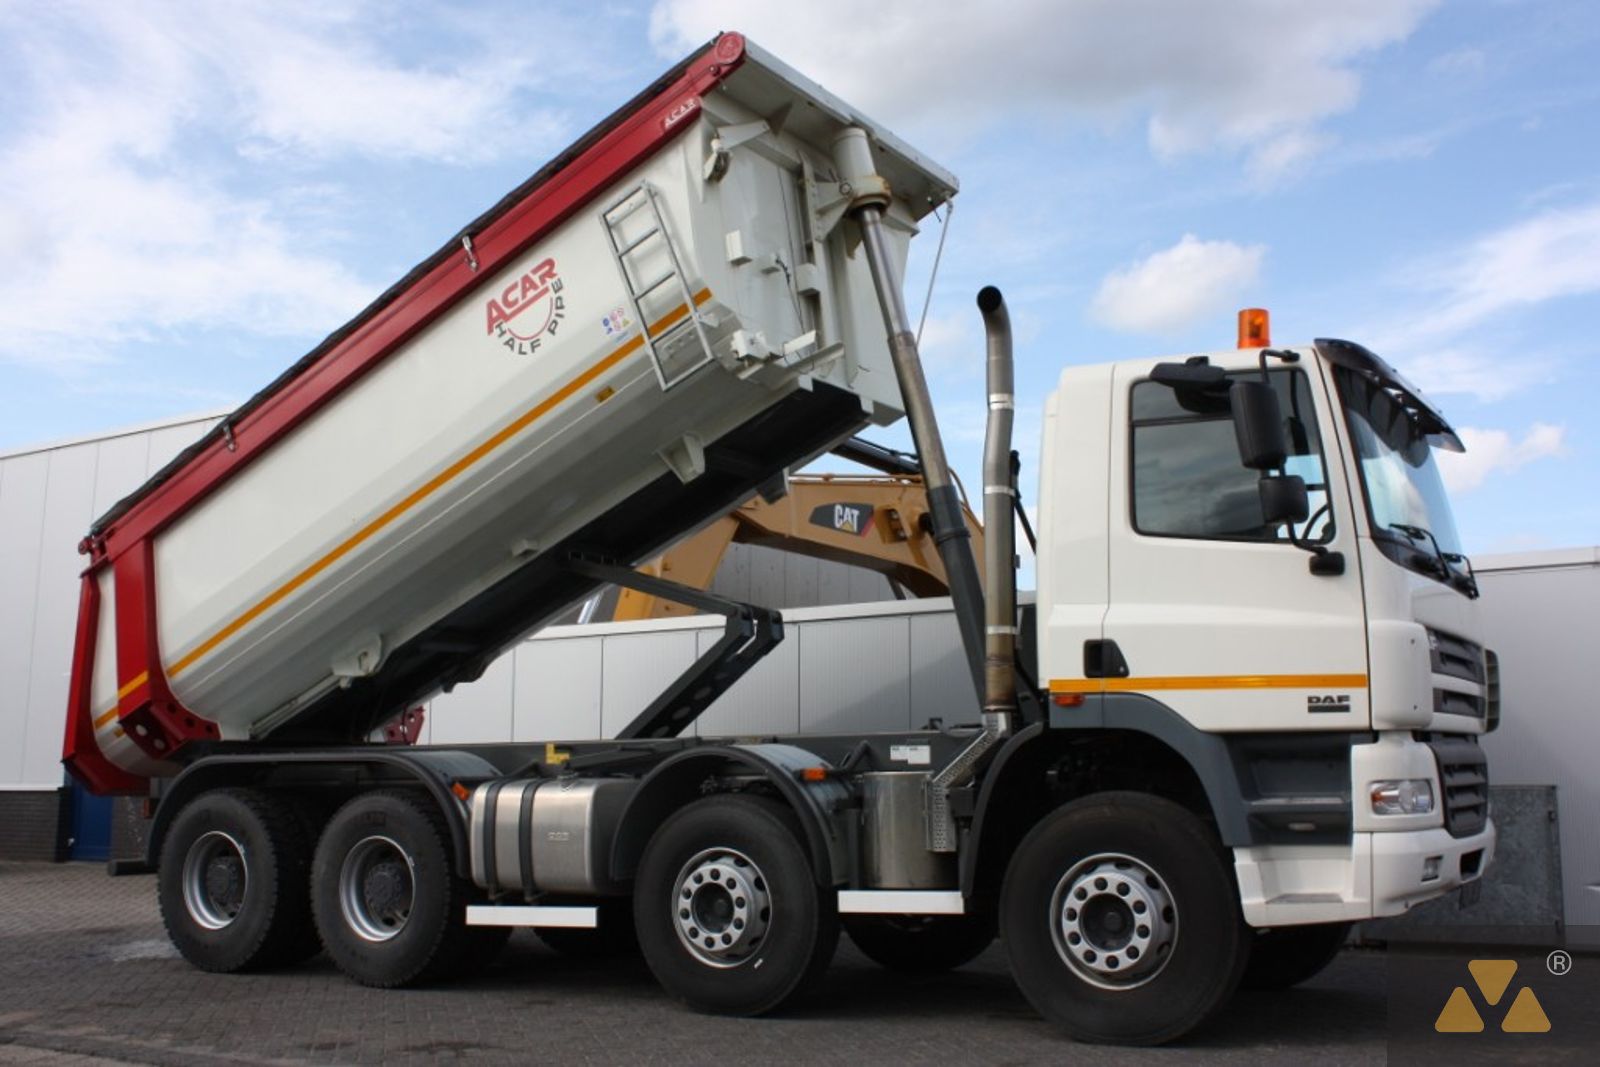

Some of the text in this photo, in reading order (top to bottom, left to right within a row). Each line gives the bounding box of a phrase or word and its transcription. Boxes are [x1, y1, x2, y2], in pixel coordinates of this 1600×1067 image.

[486, 258, 558, 336] ACAR
[495, 278, 565, 355] HALF PIPE
[834, 504, 859, 532] CAT
[1307, 695, 1350, 704] DAF
